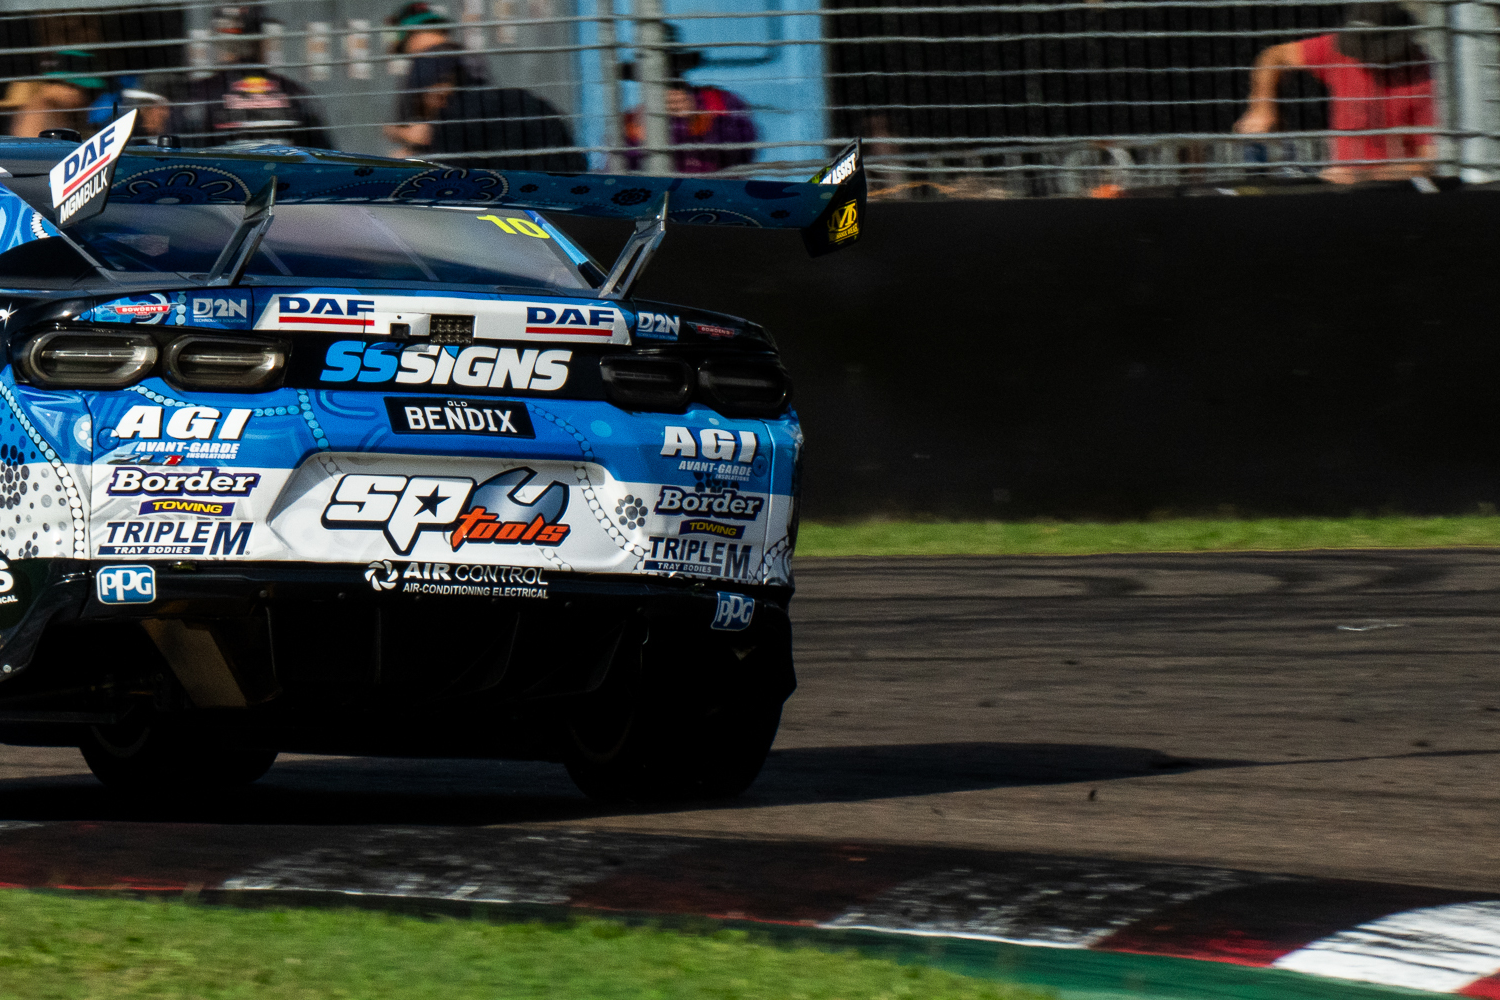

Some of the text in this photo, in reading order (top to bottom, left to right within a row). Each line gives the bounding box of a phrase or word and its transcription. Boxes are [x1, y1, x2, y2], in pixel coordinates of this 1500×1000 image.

[63, 126, 116, 185] DAF
[476, 214, 551, 239] 10
[279, 297, 375, 316] DAF
[526, 307, 614, 326] DAF
[447, 400, 468, 408] QLD
[110, 405, 253, 440] AGI
[404, 406, 518, 433] BENDIX
[135, 442, 240, 454] AVANT-GARDE
[660, 426, 757, 463] AGI
[678, 460, 752, 477] AVANT-GARDE
[111, 469, 255, 492] Border
[152, 501, 223, 514] TOWING
[658, 489, 760, 515] Border
[450, 506, 571, 552] tools
[689, 522, 737, 536] TOWING
[114, 546, 191, 554] TRAY BODIES
[403, 563, 549, 586] AIR CONTROL
[658, 562, 712, 574] TRAY BODIES
[101, 570, 152, 601] PPG
[403, 582, 549, 599] AIR-CONDITIONING ELECTRICAL
[717, 595, 753, 627] PPG
